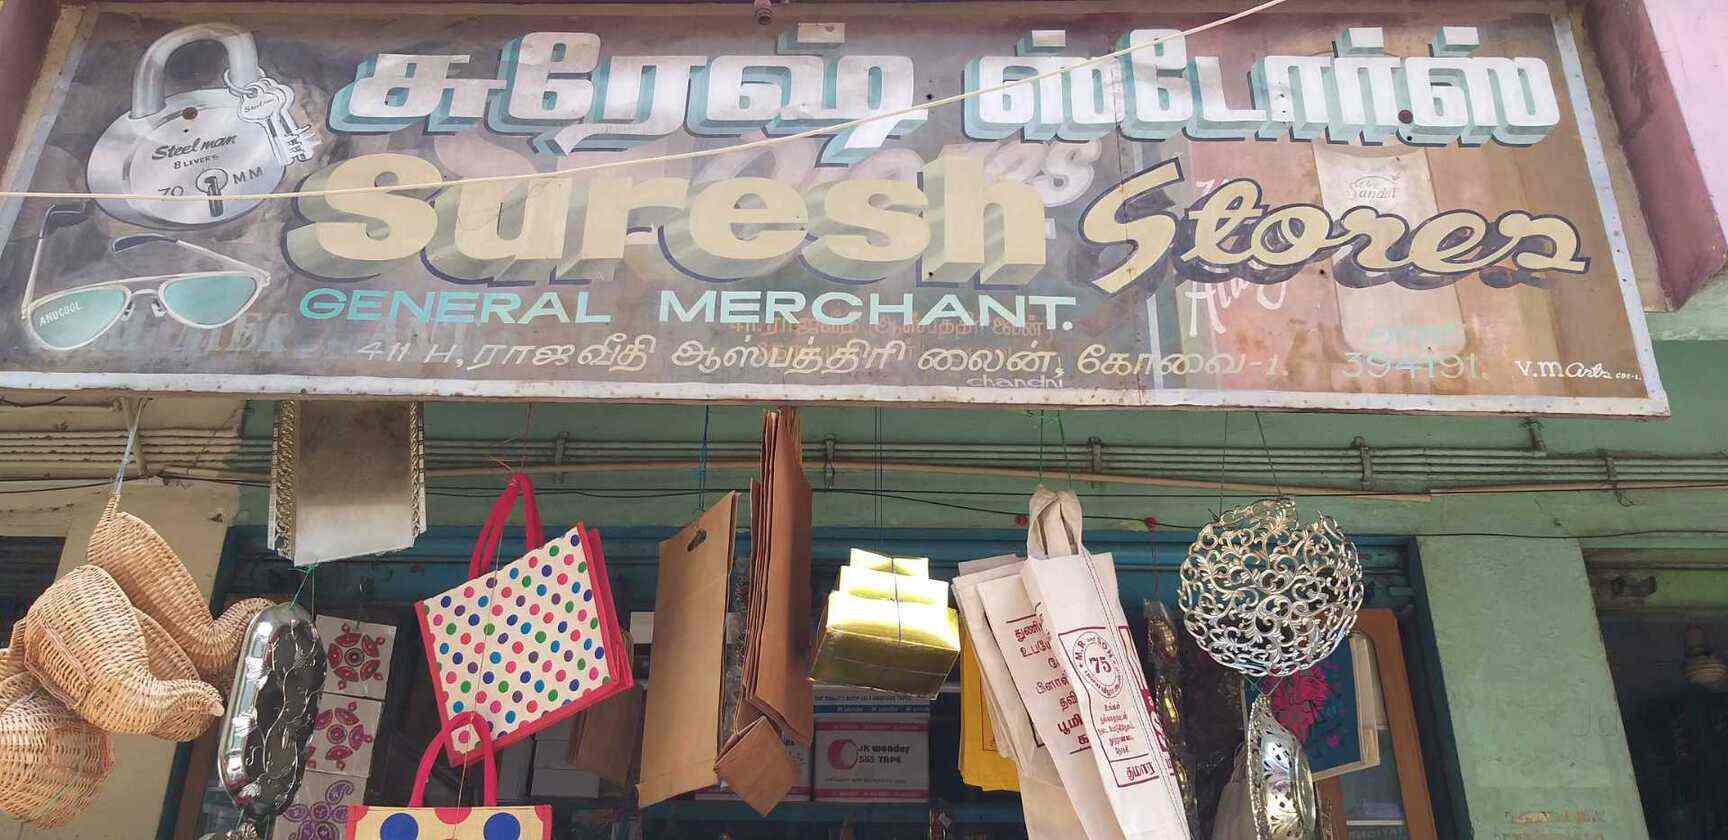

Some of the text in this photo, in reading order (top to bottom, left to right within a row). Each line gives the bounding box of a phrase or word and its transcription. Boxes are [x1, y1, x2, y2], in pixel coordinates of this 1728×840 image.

[330, 22, 1560, 160] சுரேஷ் ஸ்டோர்ஸ்
[288, 142, 1046, 282] Suresh
[1081, 157, 1591, 295] Stores
[300, 287, 611, 325] GENERAL
[659, 290, 1077, 331] MERCHANT.
[1089, 655, 1112, 674] 75
